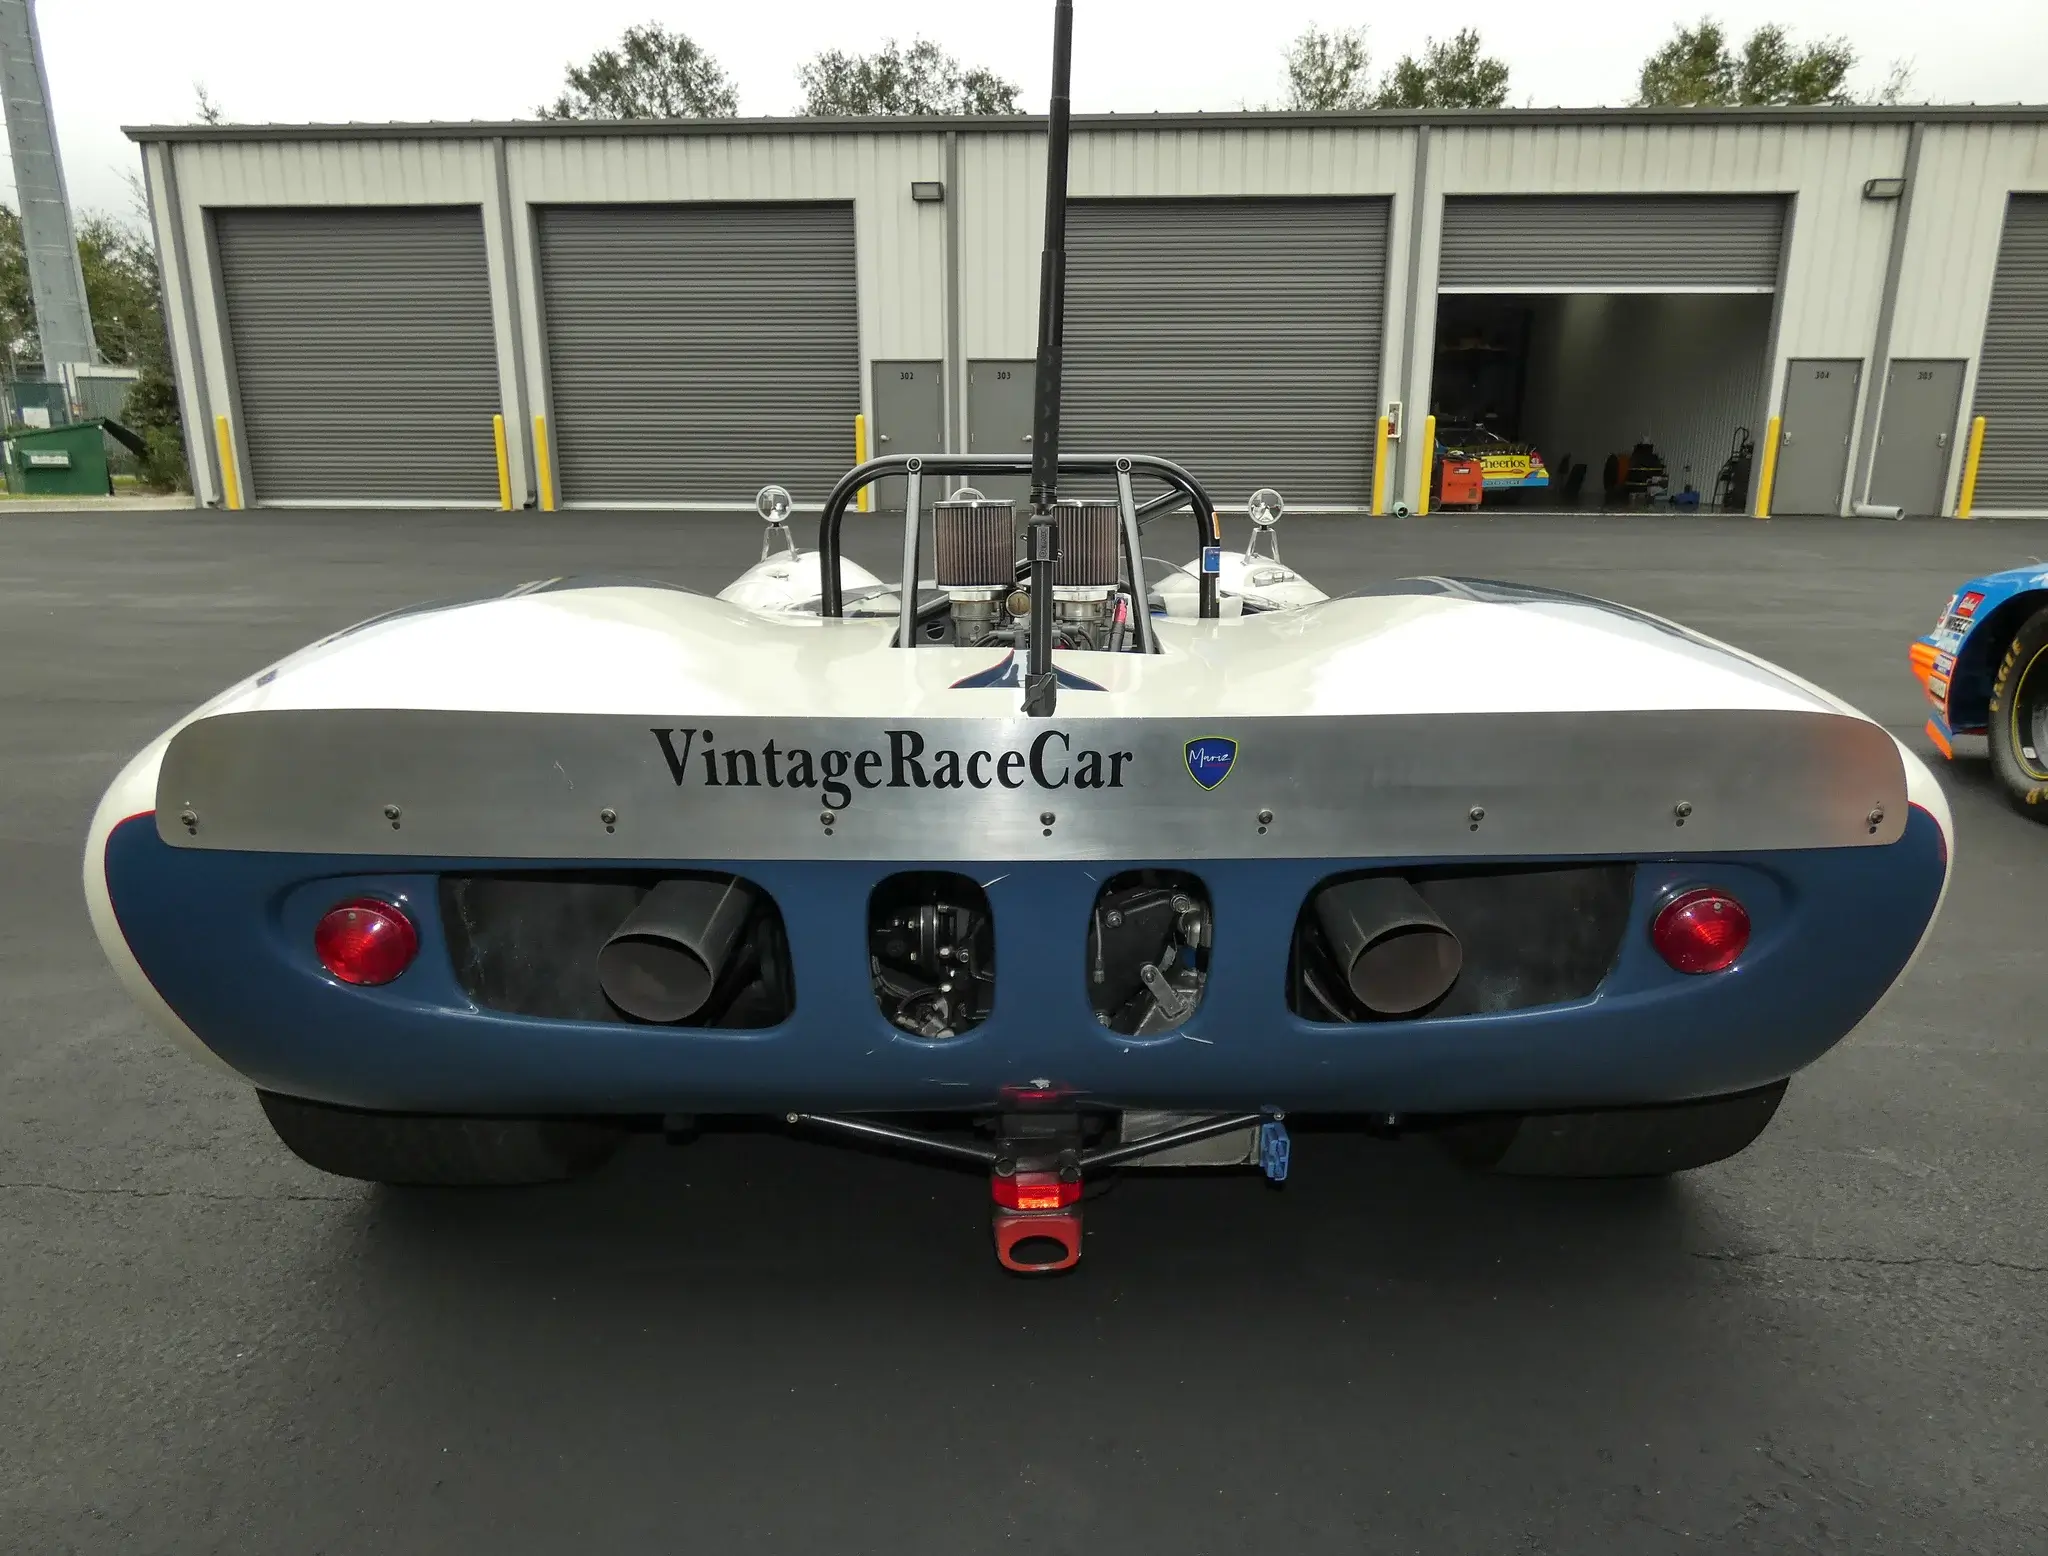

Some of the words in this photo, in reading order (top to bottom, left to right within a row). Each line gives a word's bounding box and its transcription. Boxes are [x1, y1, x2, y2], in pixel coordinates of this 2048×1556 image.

[900, 371, 914, 380] 302
[997, 371, 1011, 380] 303
[1815, 371, 1830, 380] 304
[1917, 371, 1933, 381] 305
[649, 728, 1133, 810] VintageRaceCar
